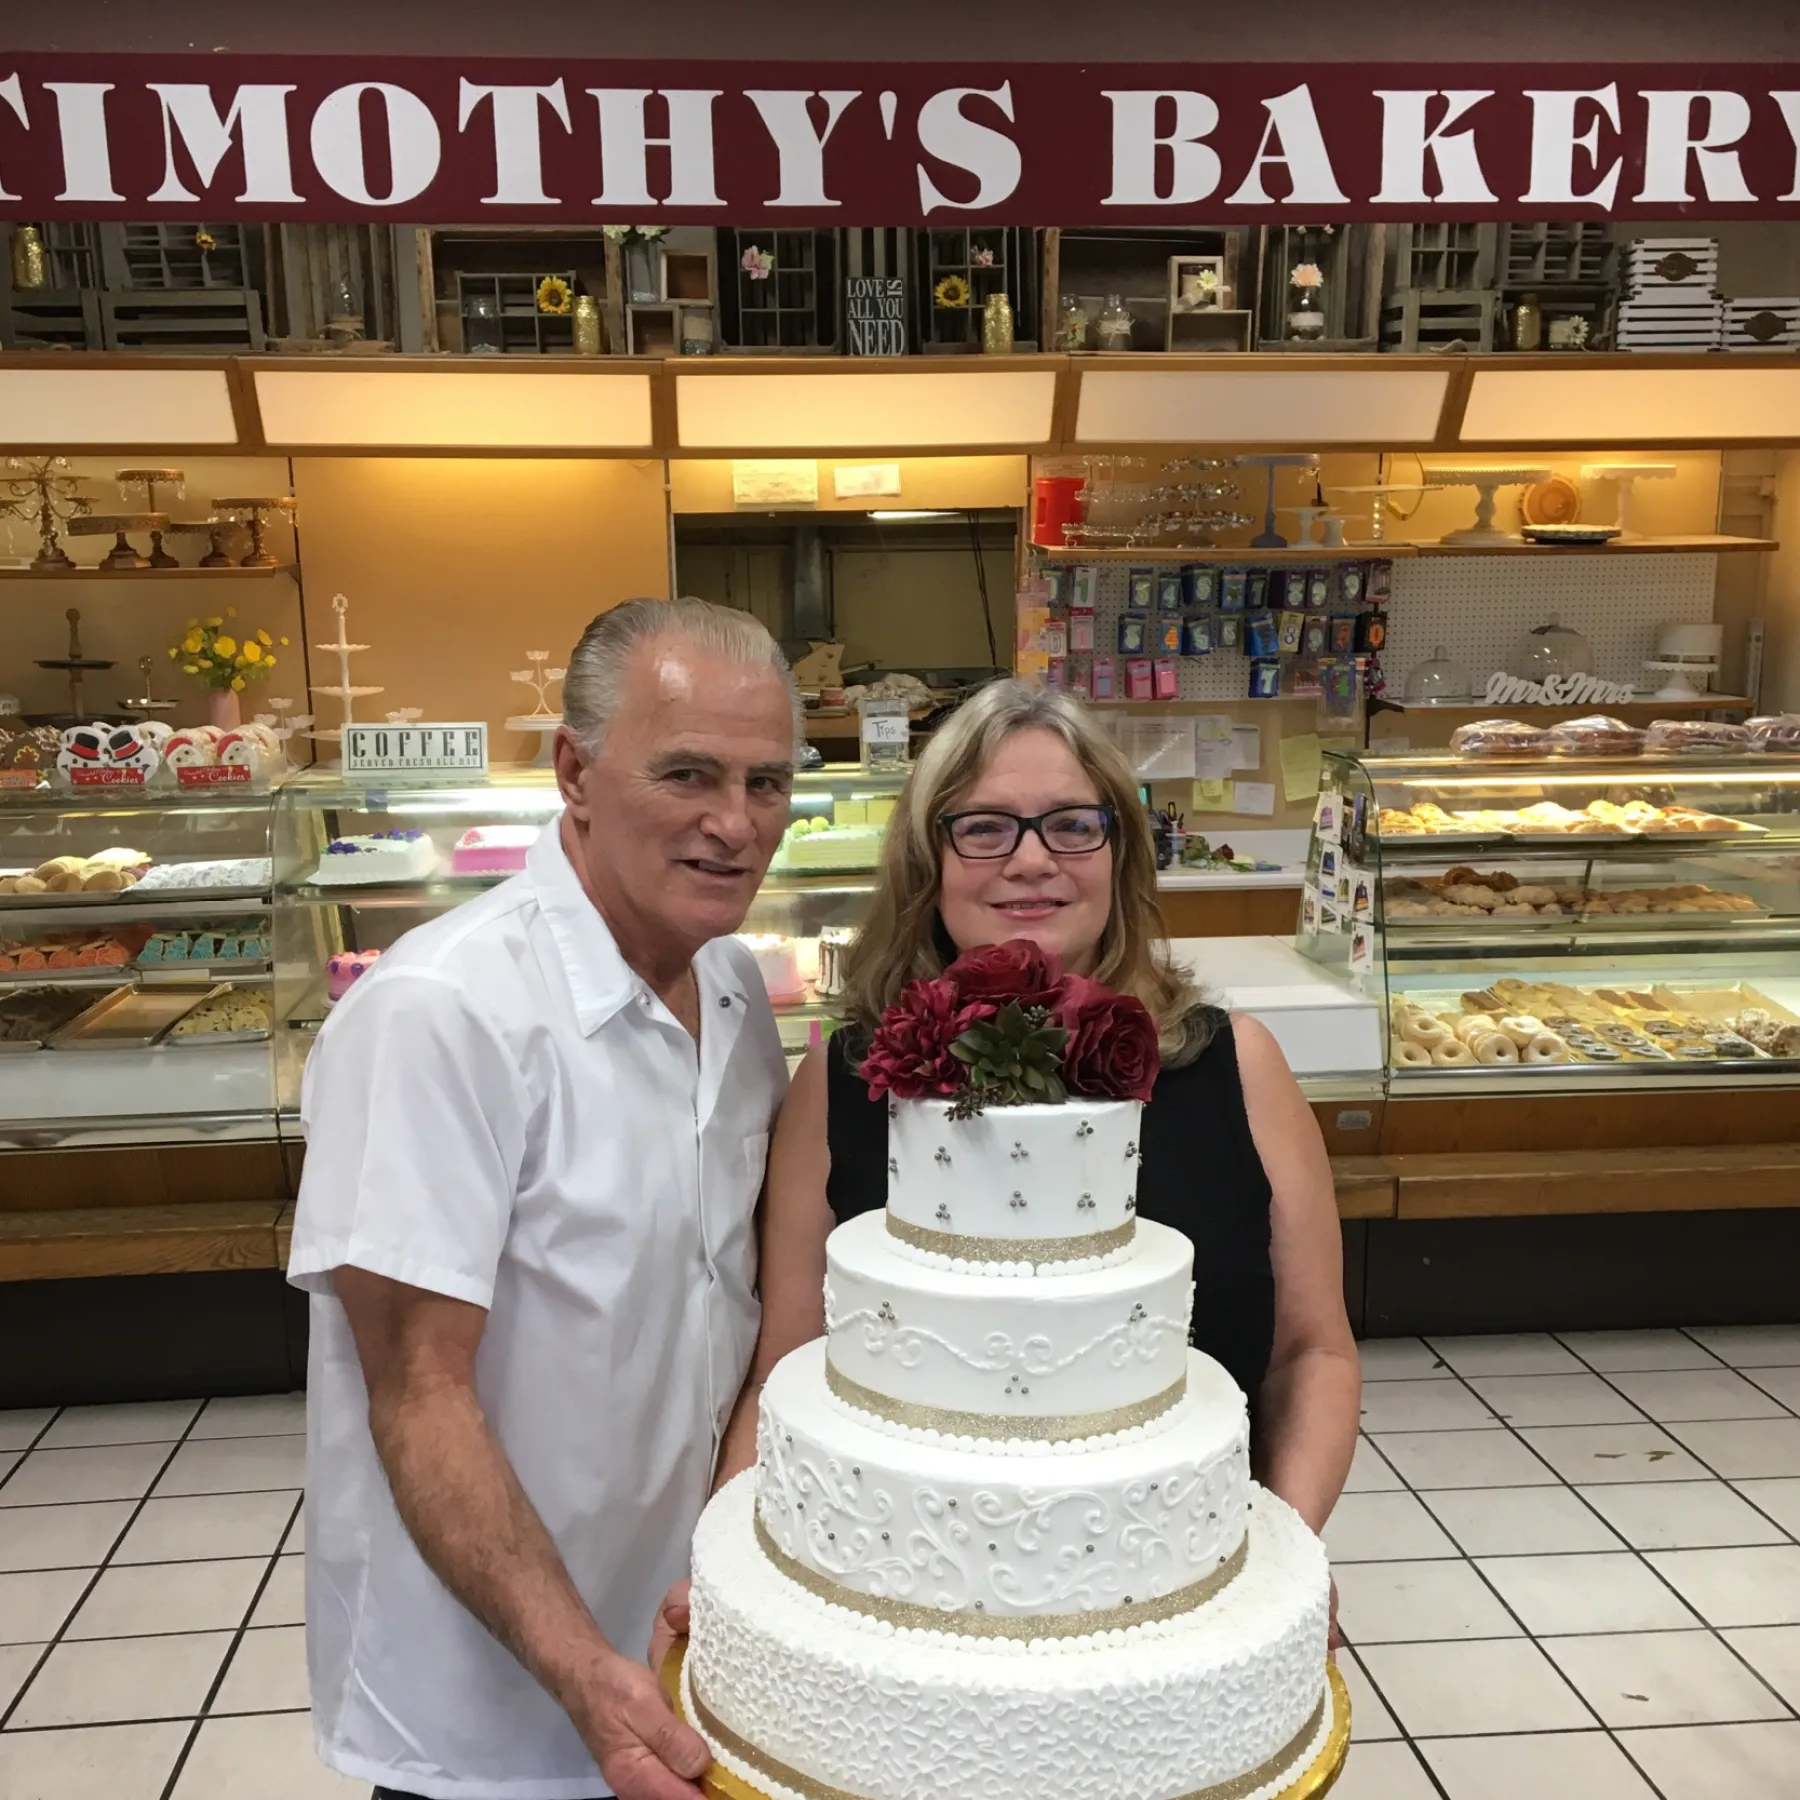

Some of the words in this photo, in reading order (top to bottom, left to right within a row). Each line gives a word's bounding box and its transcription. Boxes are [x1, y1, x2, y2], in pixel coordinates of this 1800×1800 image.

[0, 73, 1021, 216] IMOTHY'S
[1101, 82, 1800, 211] BAKER
[847, 279, 885, 298] LOVE
[886, 279, 903, 297] IS
[847, 298, 874, 319] ALL
[877, 298, 904, 319] YOU
[848, 319, 905, 357] NEED
[1284, 625, 1296, 646] 8
[871, 720, 897, 740] Tips
[352, 730, 478, 758] COFFEE
[352, 758, 394, 768] SERVED
[101, 770, 139, 785] Cookies
[208, 769, 246, 783] Cookies
